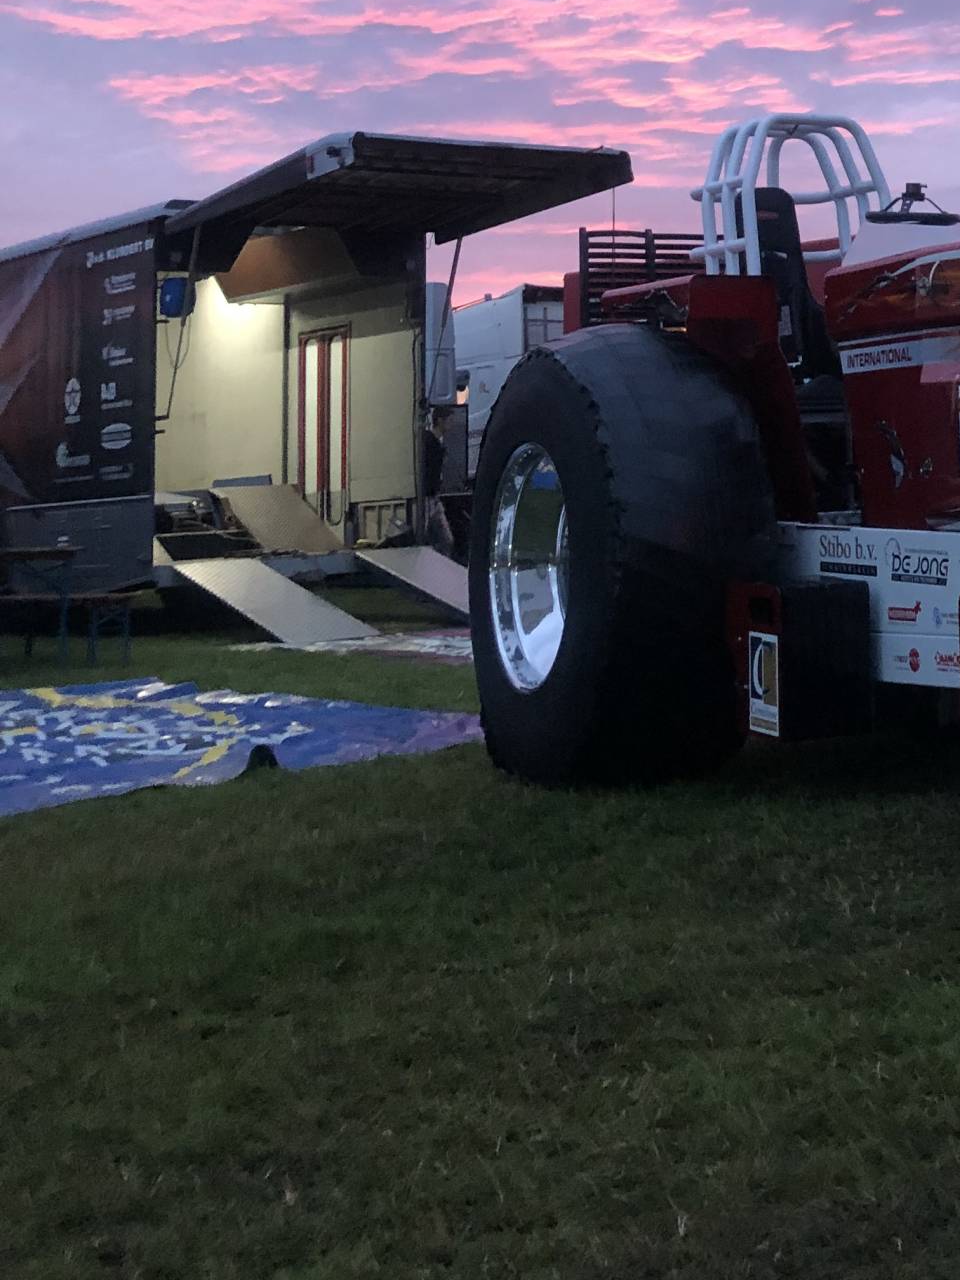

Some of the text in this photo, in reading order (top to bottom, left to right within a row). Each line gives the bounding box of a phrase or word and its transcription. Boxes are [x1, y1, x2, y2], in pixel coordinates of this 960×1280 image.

[847, 347, 913, 369] INTERNATIONAL
[819, 535, 878, 561] Stibo b.v.
[892, 552, 911, 573] DE
[913, 556, 949, 577] JONG
